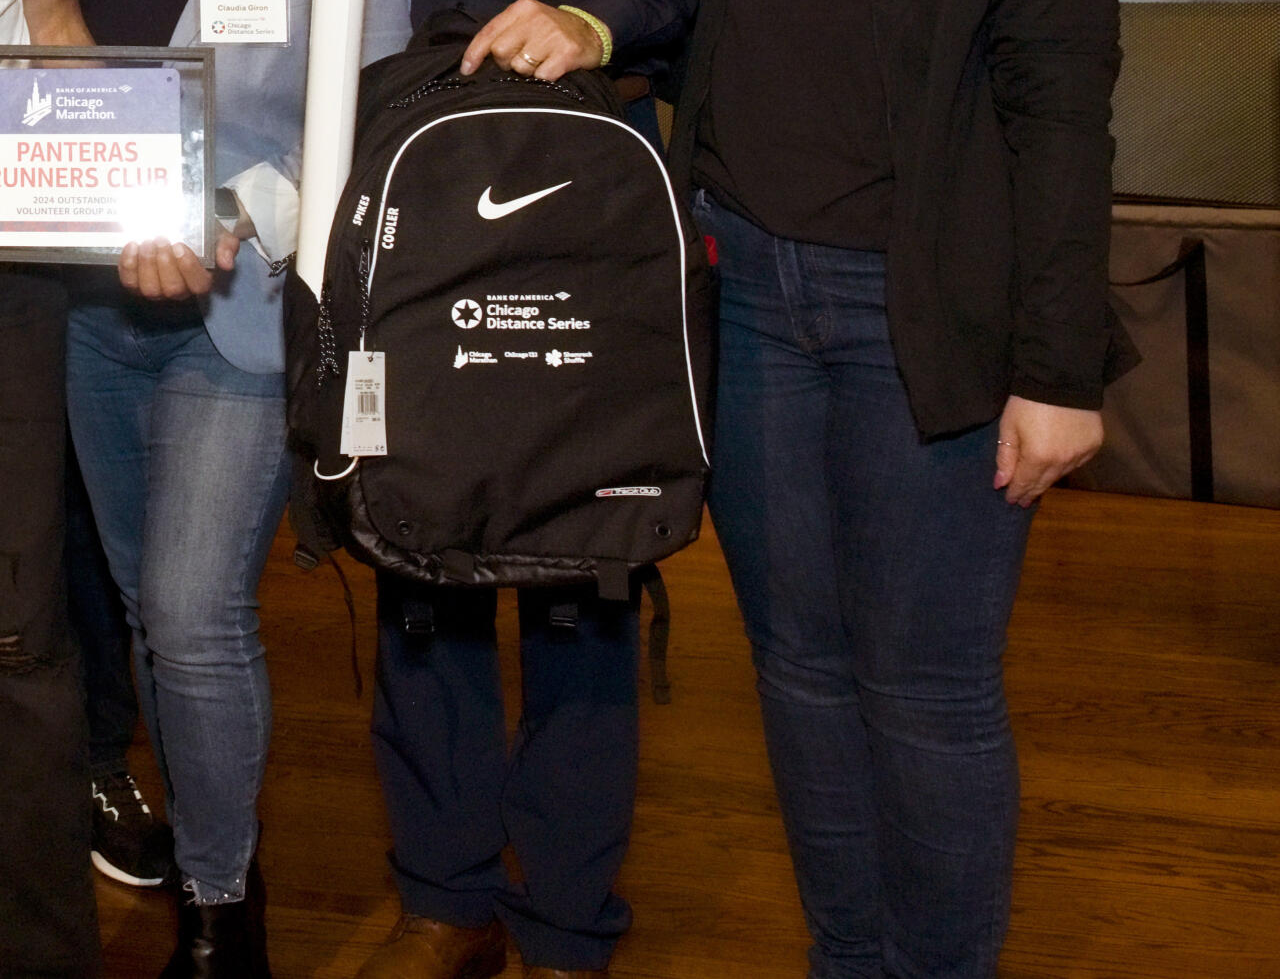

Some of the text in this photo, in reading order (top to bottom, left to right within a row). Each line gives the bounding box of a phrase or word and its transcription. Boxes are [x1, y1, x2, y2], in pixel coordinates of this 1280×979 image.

[217, 4, 269, 12] Claudia Giron
[55, 96, 104, 110] Chicago
[55, 108, 116, 120] Marathon
[17, 141, 139, 162] PANTERAS
[107, 167, 169, 188] CLUB
[32, 196, 117, 204] 2024 OUTSTANDIN
[16, 207, 70, 215] VOLUNTEER
[73, 207, 105, 215] GROUP
[352, 194, 370, 226] SPIKES
[381, 206, 400, 250] COOLER
[486, 304, 540, 319] Chicago
[486, 317, 591, 329] Distance Series
